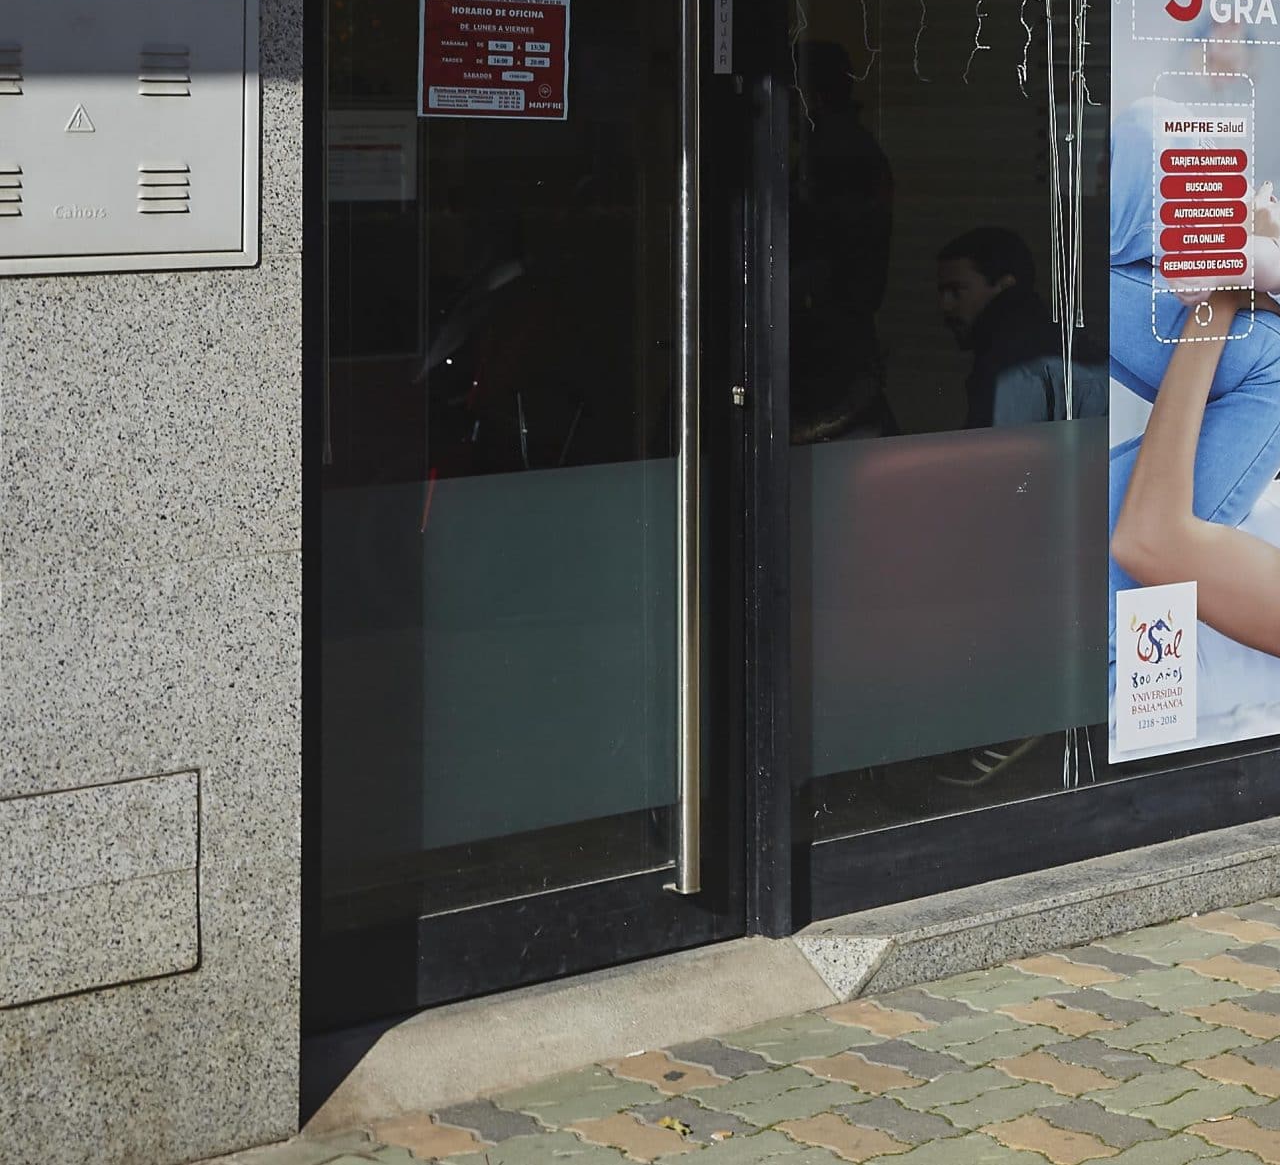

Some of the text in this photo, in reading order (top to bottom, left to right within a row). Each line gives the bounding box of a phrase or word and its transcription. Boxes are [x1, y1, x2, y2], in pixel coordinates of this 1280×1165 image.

[451, 6, 544, 19] HORARIO DE OFICINA
[1164, 121, 1244, 133] MAPFRE Salud
[1171, 156, 1238, 166] TARJETA SANITARIA
[1185, 182, 1223, 192] BUSCADOR
[54, 205, 107, 219] Cahors
[1174, 208, 1234, 219] AUTORIZACIONES
[1183, 233, 1225, 244] CITA ONLINE
[1164, 259, 1243, 271] REEMBOLSO DE GASTOS
[1131, 672, 1151, 688] 800
